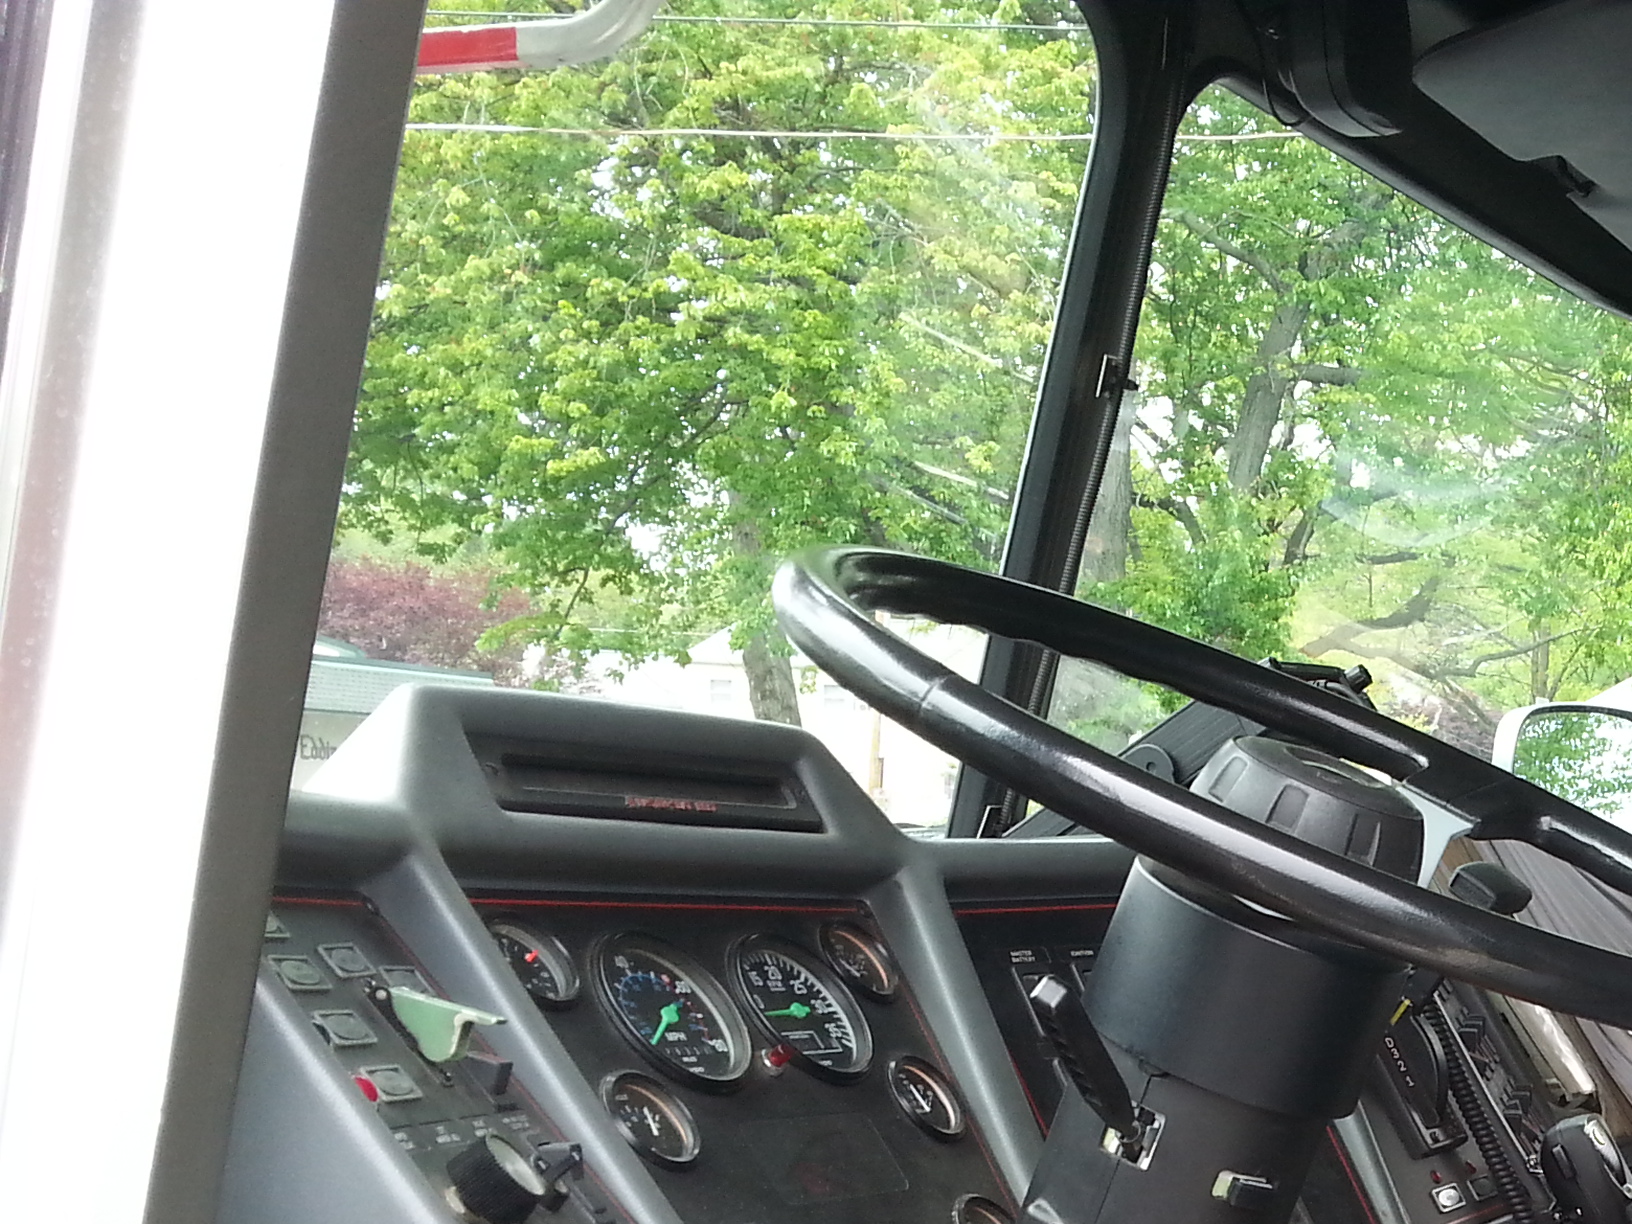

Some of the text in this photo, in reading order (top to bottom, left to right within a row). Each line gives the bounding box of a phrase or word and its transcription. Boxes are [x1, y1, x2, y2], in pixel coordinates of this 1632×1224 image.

[763, 965, 782, 981] 20
[789, 979, 808, 995] 25
[664, 1031, 688, 1043] MPH
[1384, 1037, 1415, 1087] D 3 2 1
